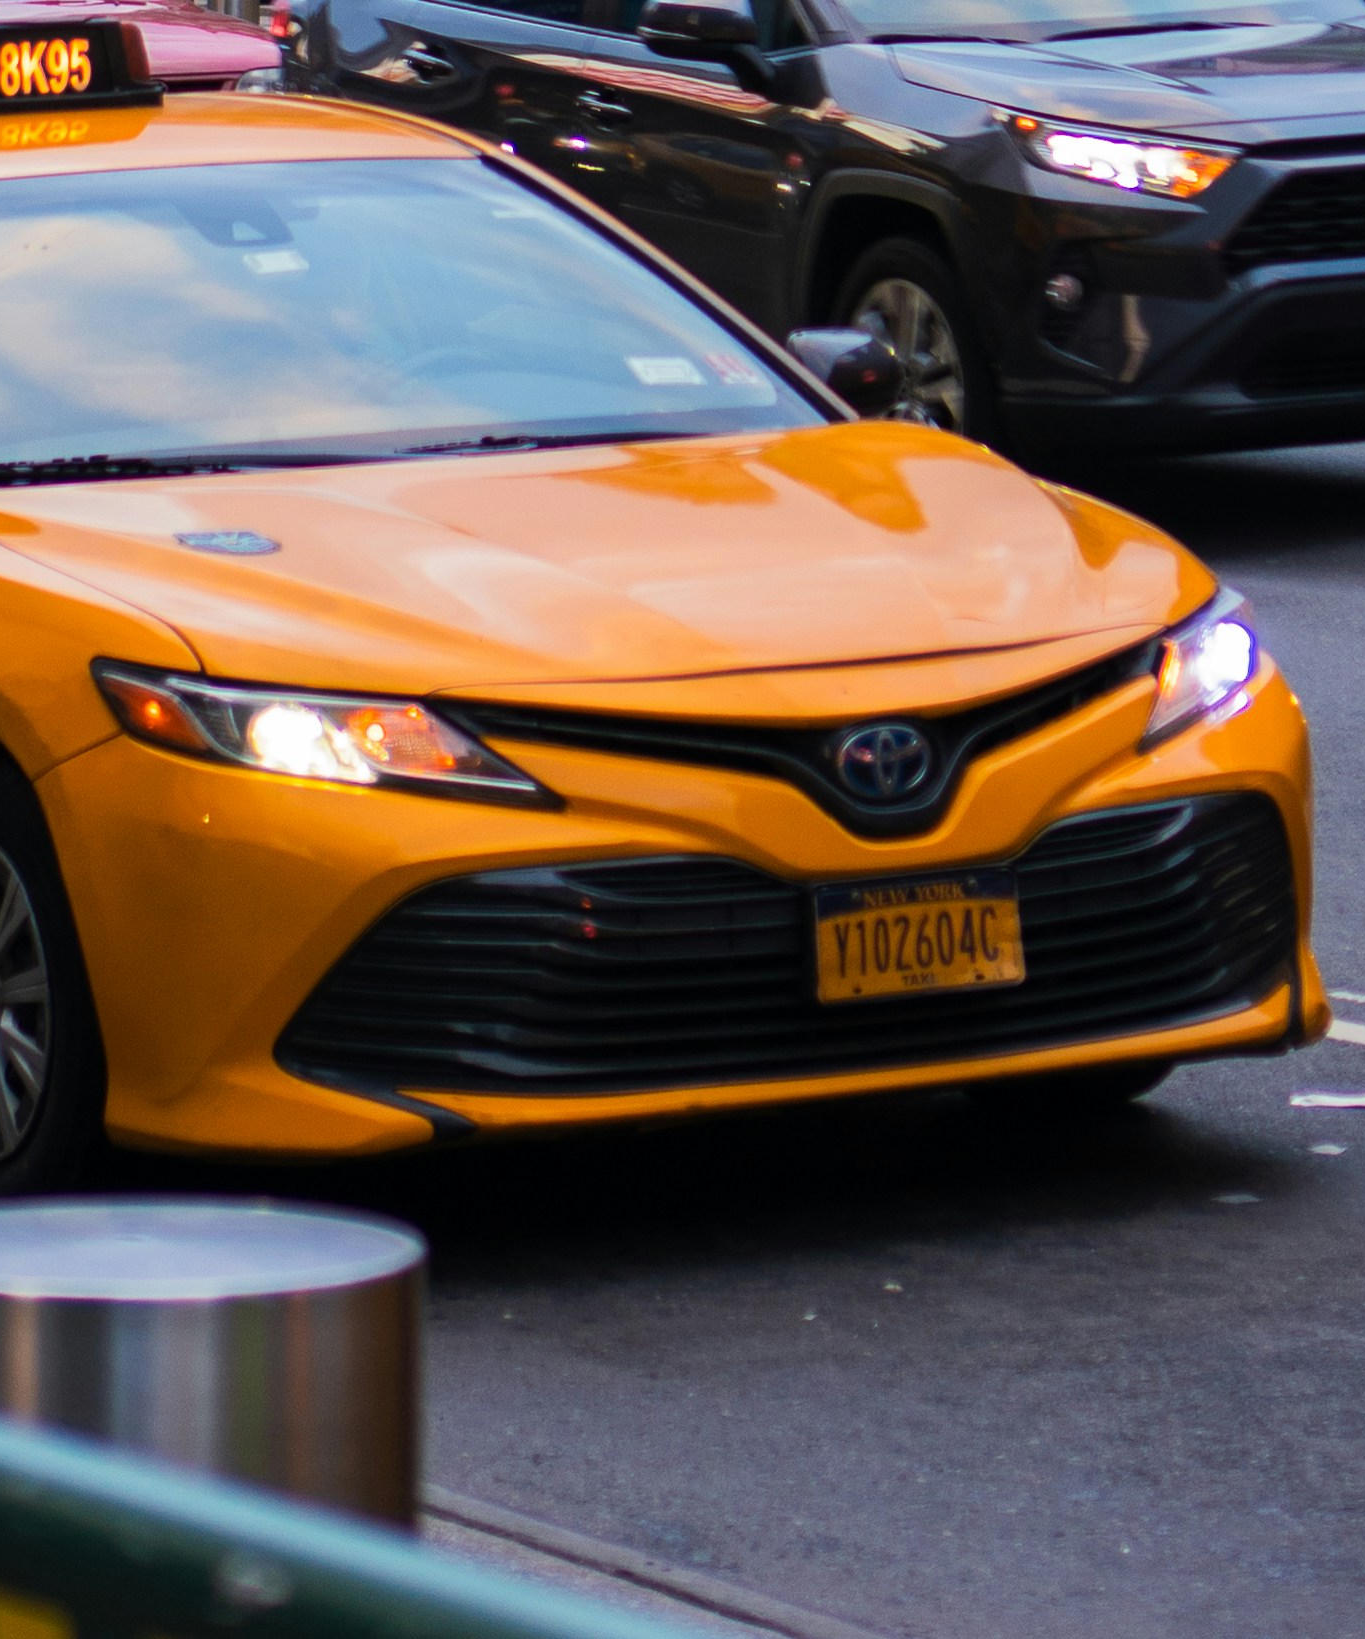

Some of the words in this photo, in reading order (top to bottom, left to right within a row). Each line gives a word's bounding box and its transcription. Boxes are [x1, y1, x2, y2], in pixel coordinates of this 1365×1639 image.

[862, 888, 910, 908] NEW
[916, 881, 965, 901] YORK
[834, 905, 1000, 979] Y102604C
[902, 972, 935, 987] TAXI
